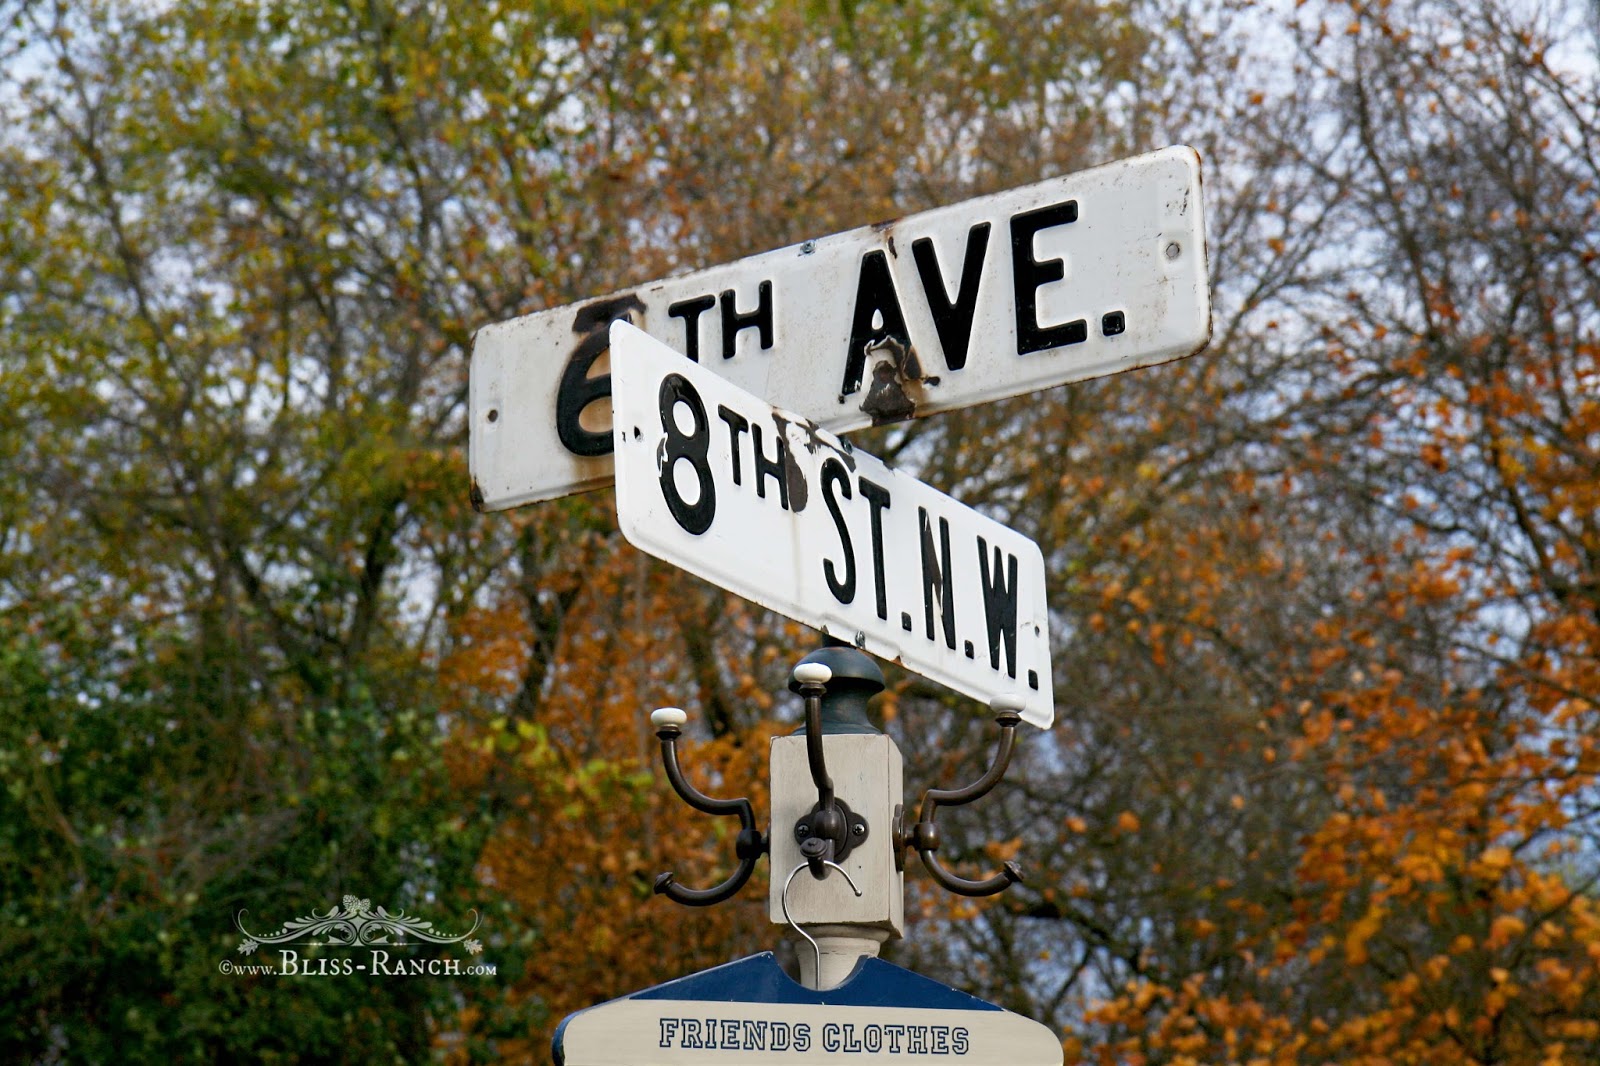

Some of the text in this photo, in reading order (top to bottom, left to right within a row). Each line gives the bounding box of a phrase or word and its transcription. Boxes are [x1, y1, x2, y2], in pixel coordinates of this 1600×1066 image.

[556, 199, 1126, 457] 6TH AVE.
[657, 373, 790, 536] 8TH
[659, 1018, 970, 1056] FRIENDS CLOTHES
